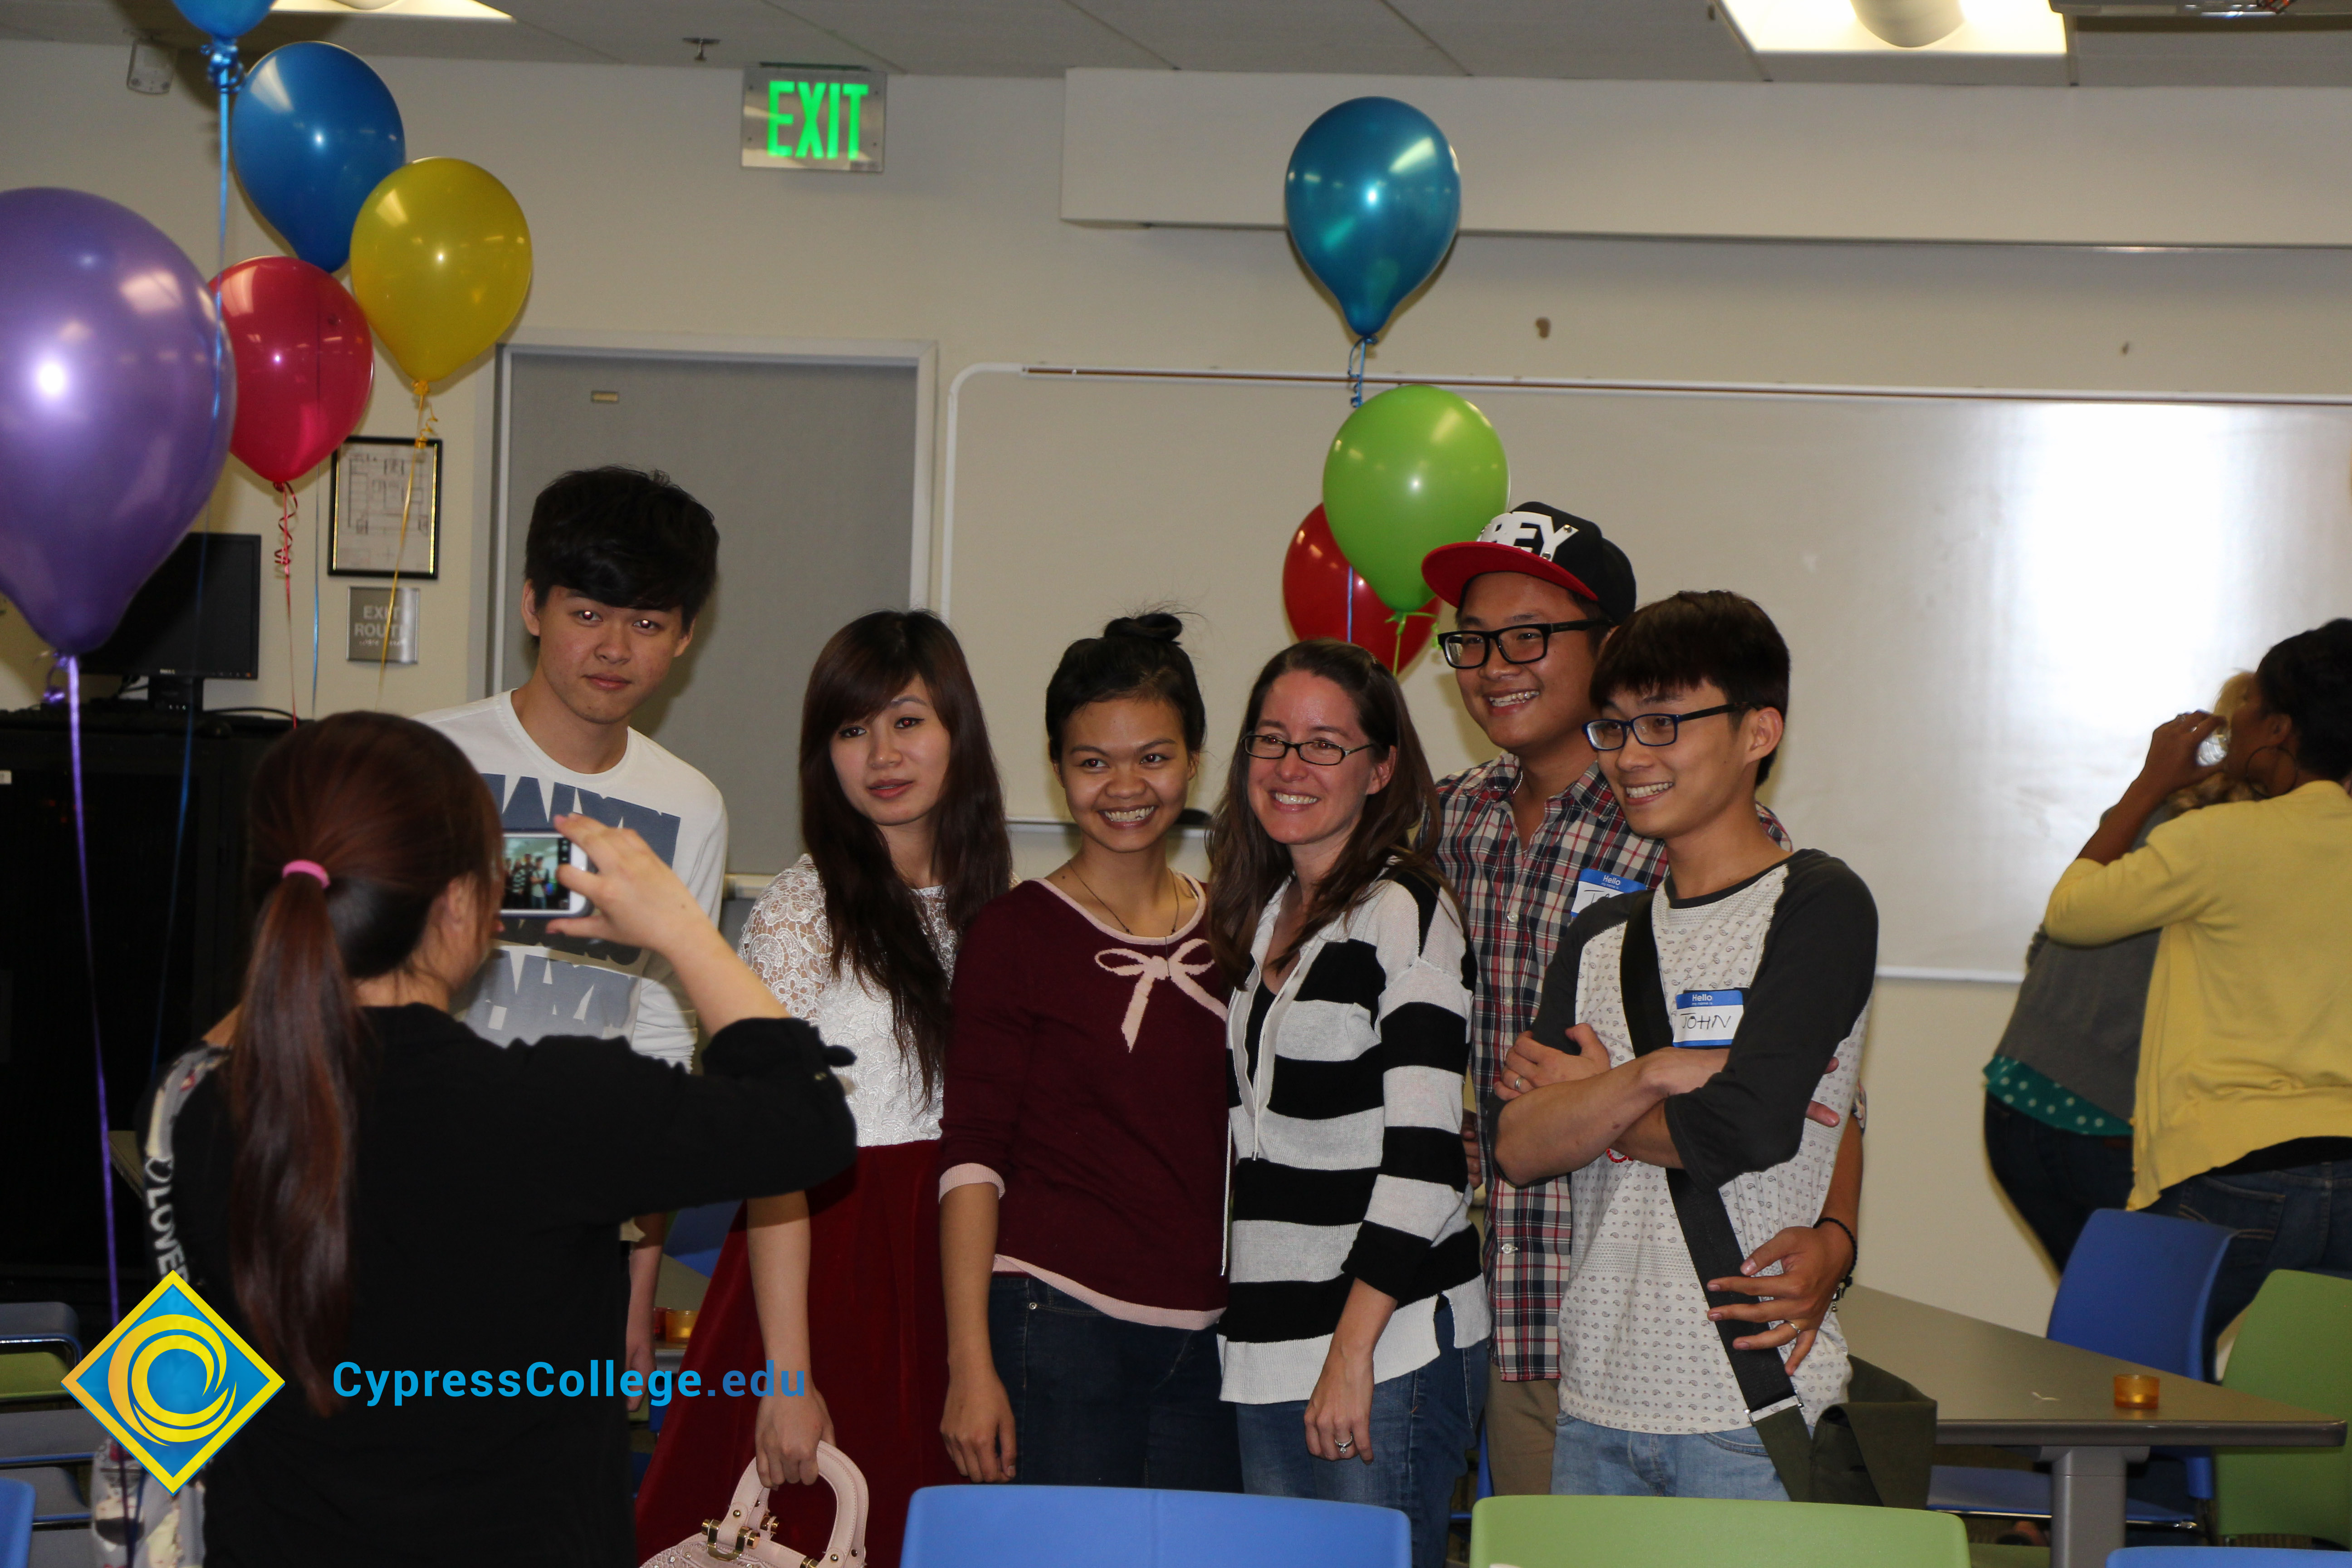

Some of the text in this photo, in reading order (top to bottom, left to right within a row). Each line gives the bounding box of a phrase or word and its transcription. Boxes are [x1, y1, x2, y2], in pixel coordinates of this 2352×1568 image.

[767, 81, 869, 161] EXIT
[363, 605, 400, 619] EXIT
[1602, 875, 1621, 886] Hello
[1680, 1012, 1731, 1030] JOHN
